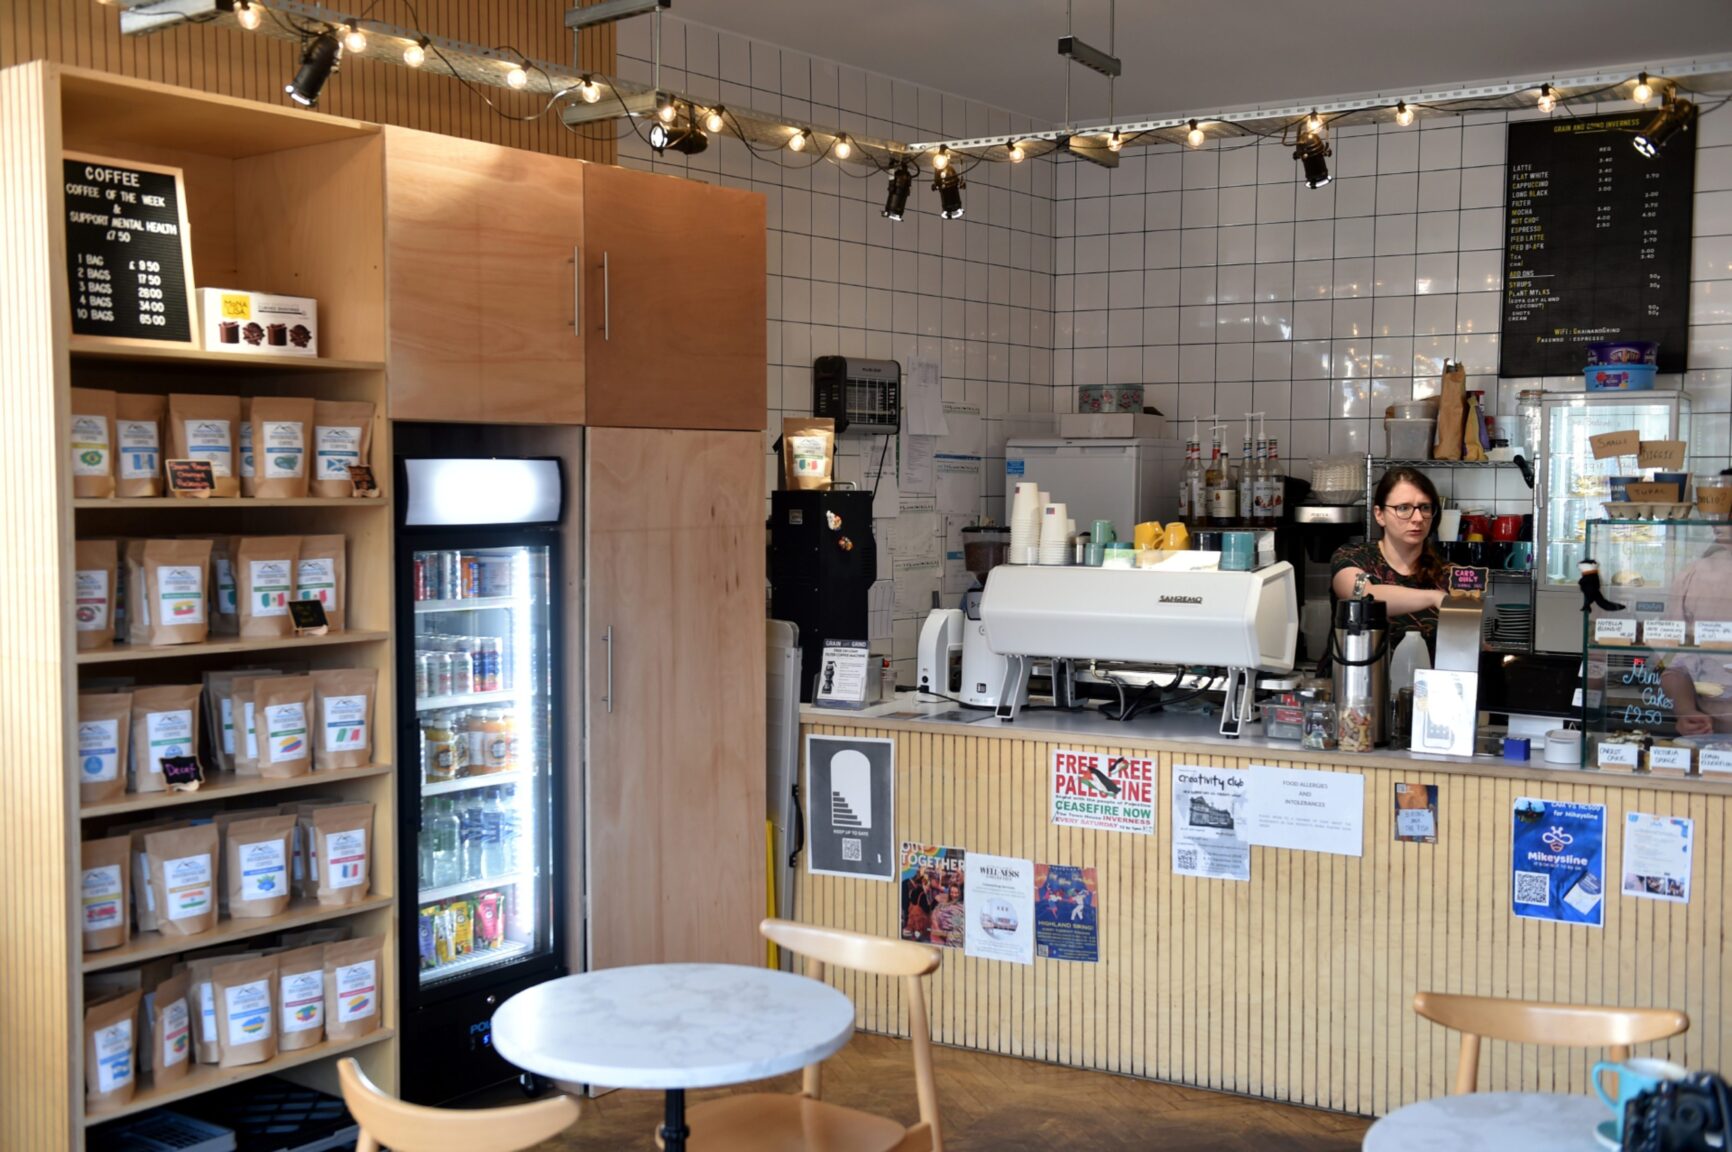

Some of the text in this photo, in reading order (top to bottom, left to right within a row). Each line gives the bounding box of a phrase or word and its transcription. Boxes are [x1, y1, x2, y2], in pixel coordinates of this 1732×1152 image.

[1606, 118, 1640, 129] INVERNESS
[1512, 164, 1532, 172] LATTE
[85, 166, 140, 188] COFFEE
[1512, 172, 1549, 181] FLAT WHITE
[1512, 180, 1549, 190] CAPPUCCINO
[66, 183, 166, 208] COFFEE OF THE WEEK
[1528, 190, 1548, 198] BLACK
[113, 204, 122, 214] &
[1512, 208, 1532, 216] MOCHA
[70, 211, 178, 235] SUPPORT MENTAL HEALTH
[1511, 217, 1522, 225] HOT
[1510, 225, 1542, 234] ESPRESSO
[1525, 234, 1544, 242] LATTE
[86, 254, 104, 266] BAG
[78, 267, 84, 278] 2
[87, 268, 112, 280] BAGS
[79, 281, 86, 292] 3
[88, 282, 113, 295] BAGS
[1508, 280, 1532, 288] SYRUPS
[80, 294, 86, 305] 4
[89, 295, 113, 308] BAGS
[77, 308, 88, 320] 10
[90, 309, 115, 322] BAGS
[1622, 663, 1662, 685] Mini
[1642, 687, 1674, 710] Cakes
[1653, 748, 1678, 756] VICTORIA
[1701, 752, 1720, 760] LEMON
[1606, 754, 1627, 762] CAKE
[165, 763, 196, 779] Decaf
[1056, 754, 1152, 780] FREE FREE
[1284, 799, 1326, 807] INTOLERANCES
[1056, 800, 1152, 818] CEASEFIRE NOW
[1102, 815, 1151, 825] INVERNESS
[1565, 810, 1598, 820] Mikeysline
[1056, 817, 1078, 825] EVERY
[1080, 818, 1119, 828] SATURDAY
[901, 853, 966, 871] TOGETHER
[1528, 852, 1588, 866] Mikeysline
[980, 866, 1020, 878] WELLNESS
[1038, 920, 1072, 928] HIGHLAND
